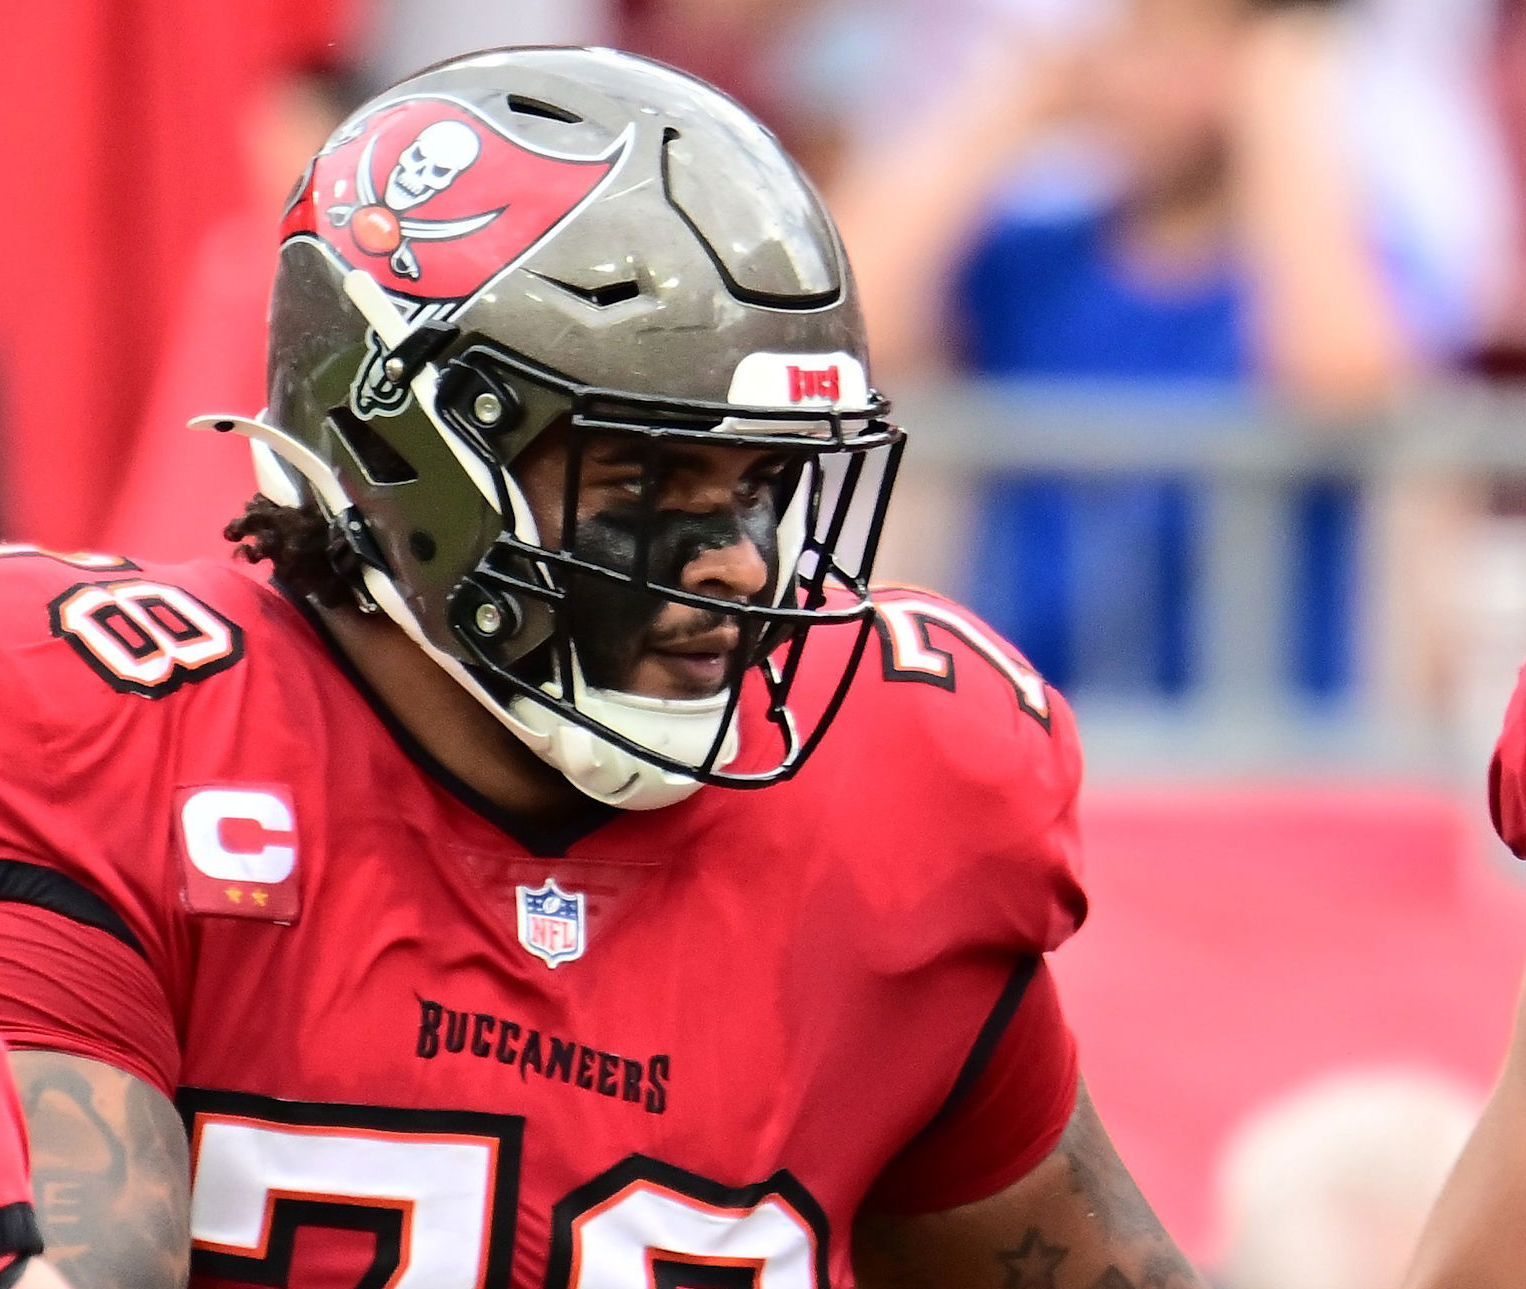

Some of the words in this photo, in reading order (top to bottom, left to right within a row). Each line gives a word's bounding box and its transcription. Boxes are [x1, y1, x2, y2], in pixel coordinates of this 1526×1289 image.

[180, 790, 294, 885] C
[530, 914, 575, 951] NFL
[415, 989, 670, 1115] BUCCANEERS
